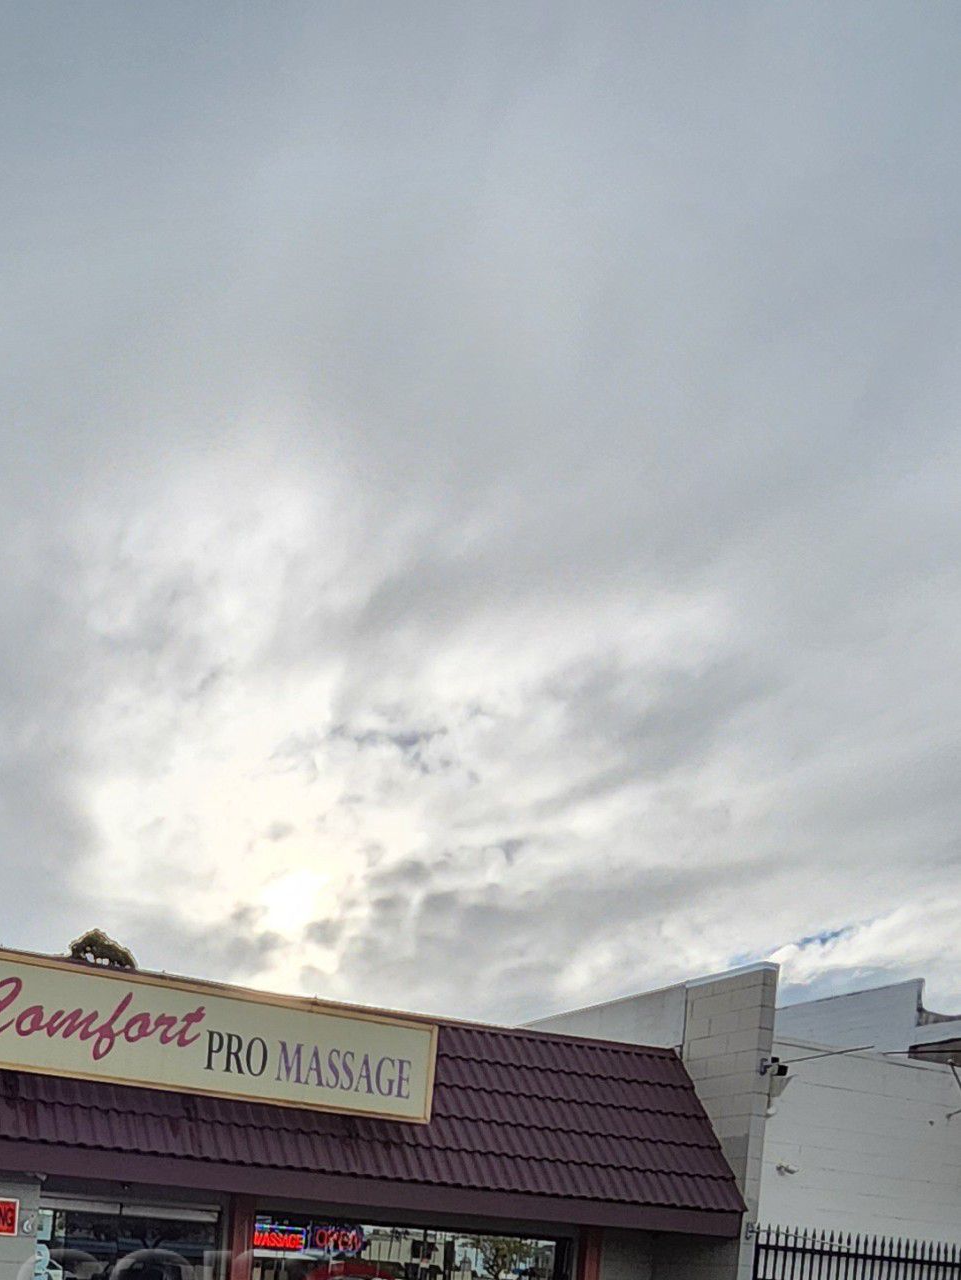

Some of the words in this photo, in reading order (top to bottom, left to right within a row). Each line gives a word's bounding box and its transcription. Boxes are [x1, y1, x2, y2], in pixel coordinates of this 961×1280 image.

[204, 1029, 269, 1078] PRO
[276, 1040, 412, 1099] MASSAGE
[253, 1231, 304, 1249] MASSAGE
